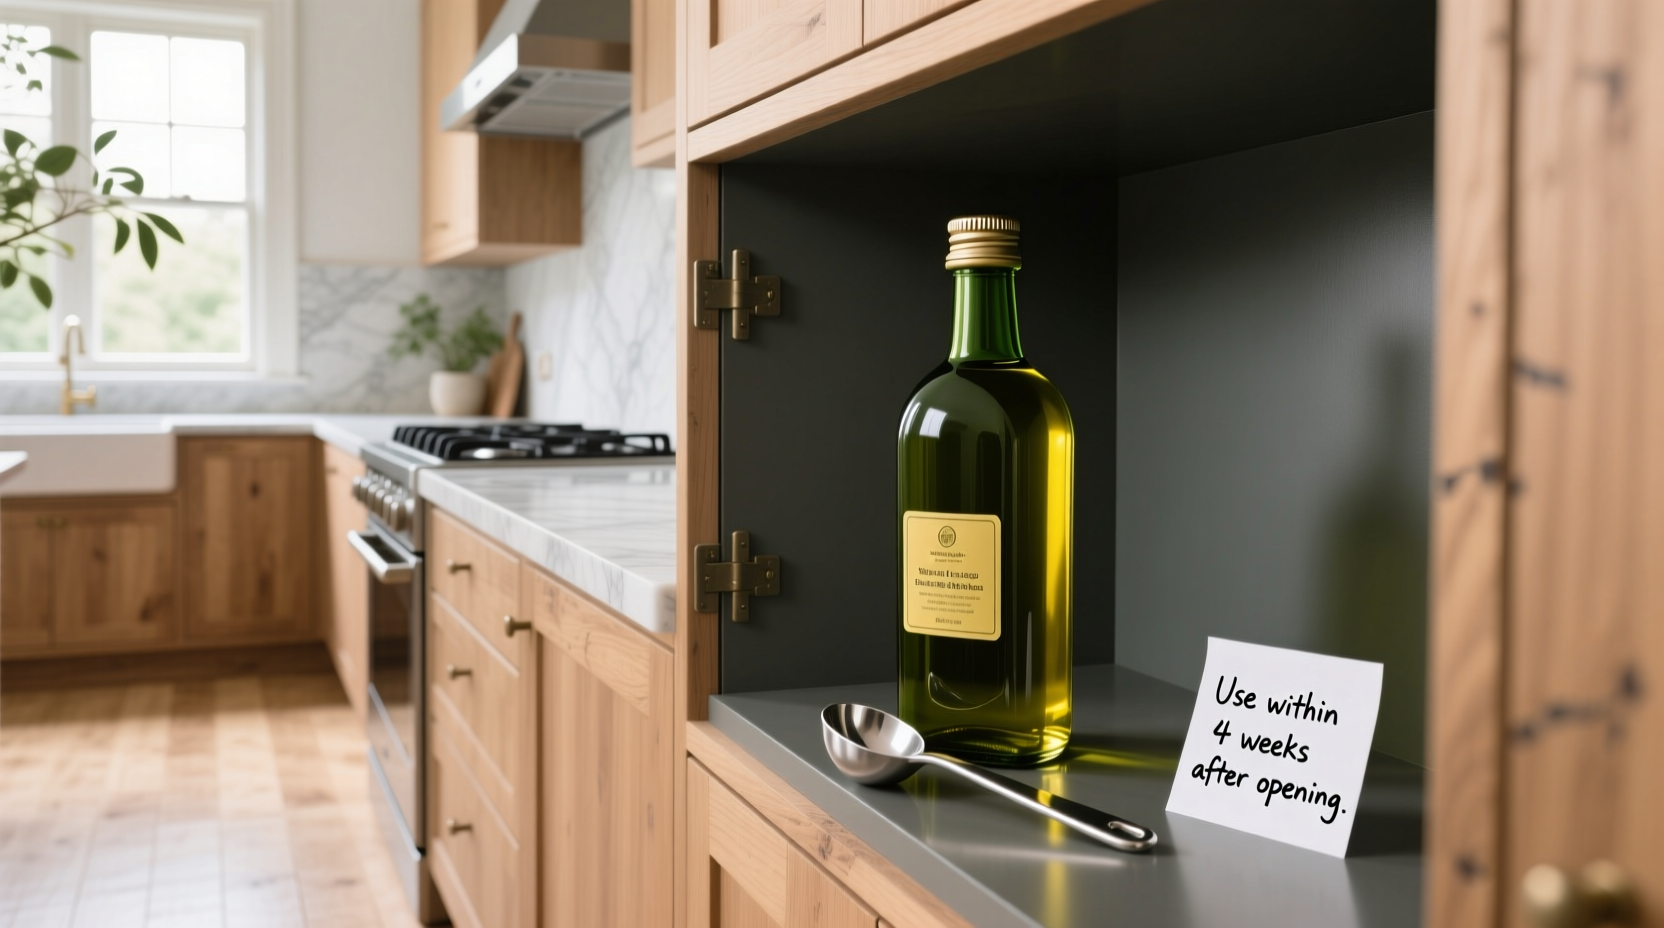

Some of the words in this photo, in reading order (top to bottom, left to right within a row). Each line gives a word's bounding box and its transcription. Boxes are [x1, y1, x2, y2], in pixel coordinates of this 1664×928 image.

[1216, 675, 1257, 709] Use
[1267, 691, 1338, 726] within
[1213, 719, 1232, 745] 4
[1241, 732, 1310, 763] weeks
[1191, 755, 1249, 788] after
[1256, 777, 1346, 824] opening.
